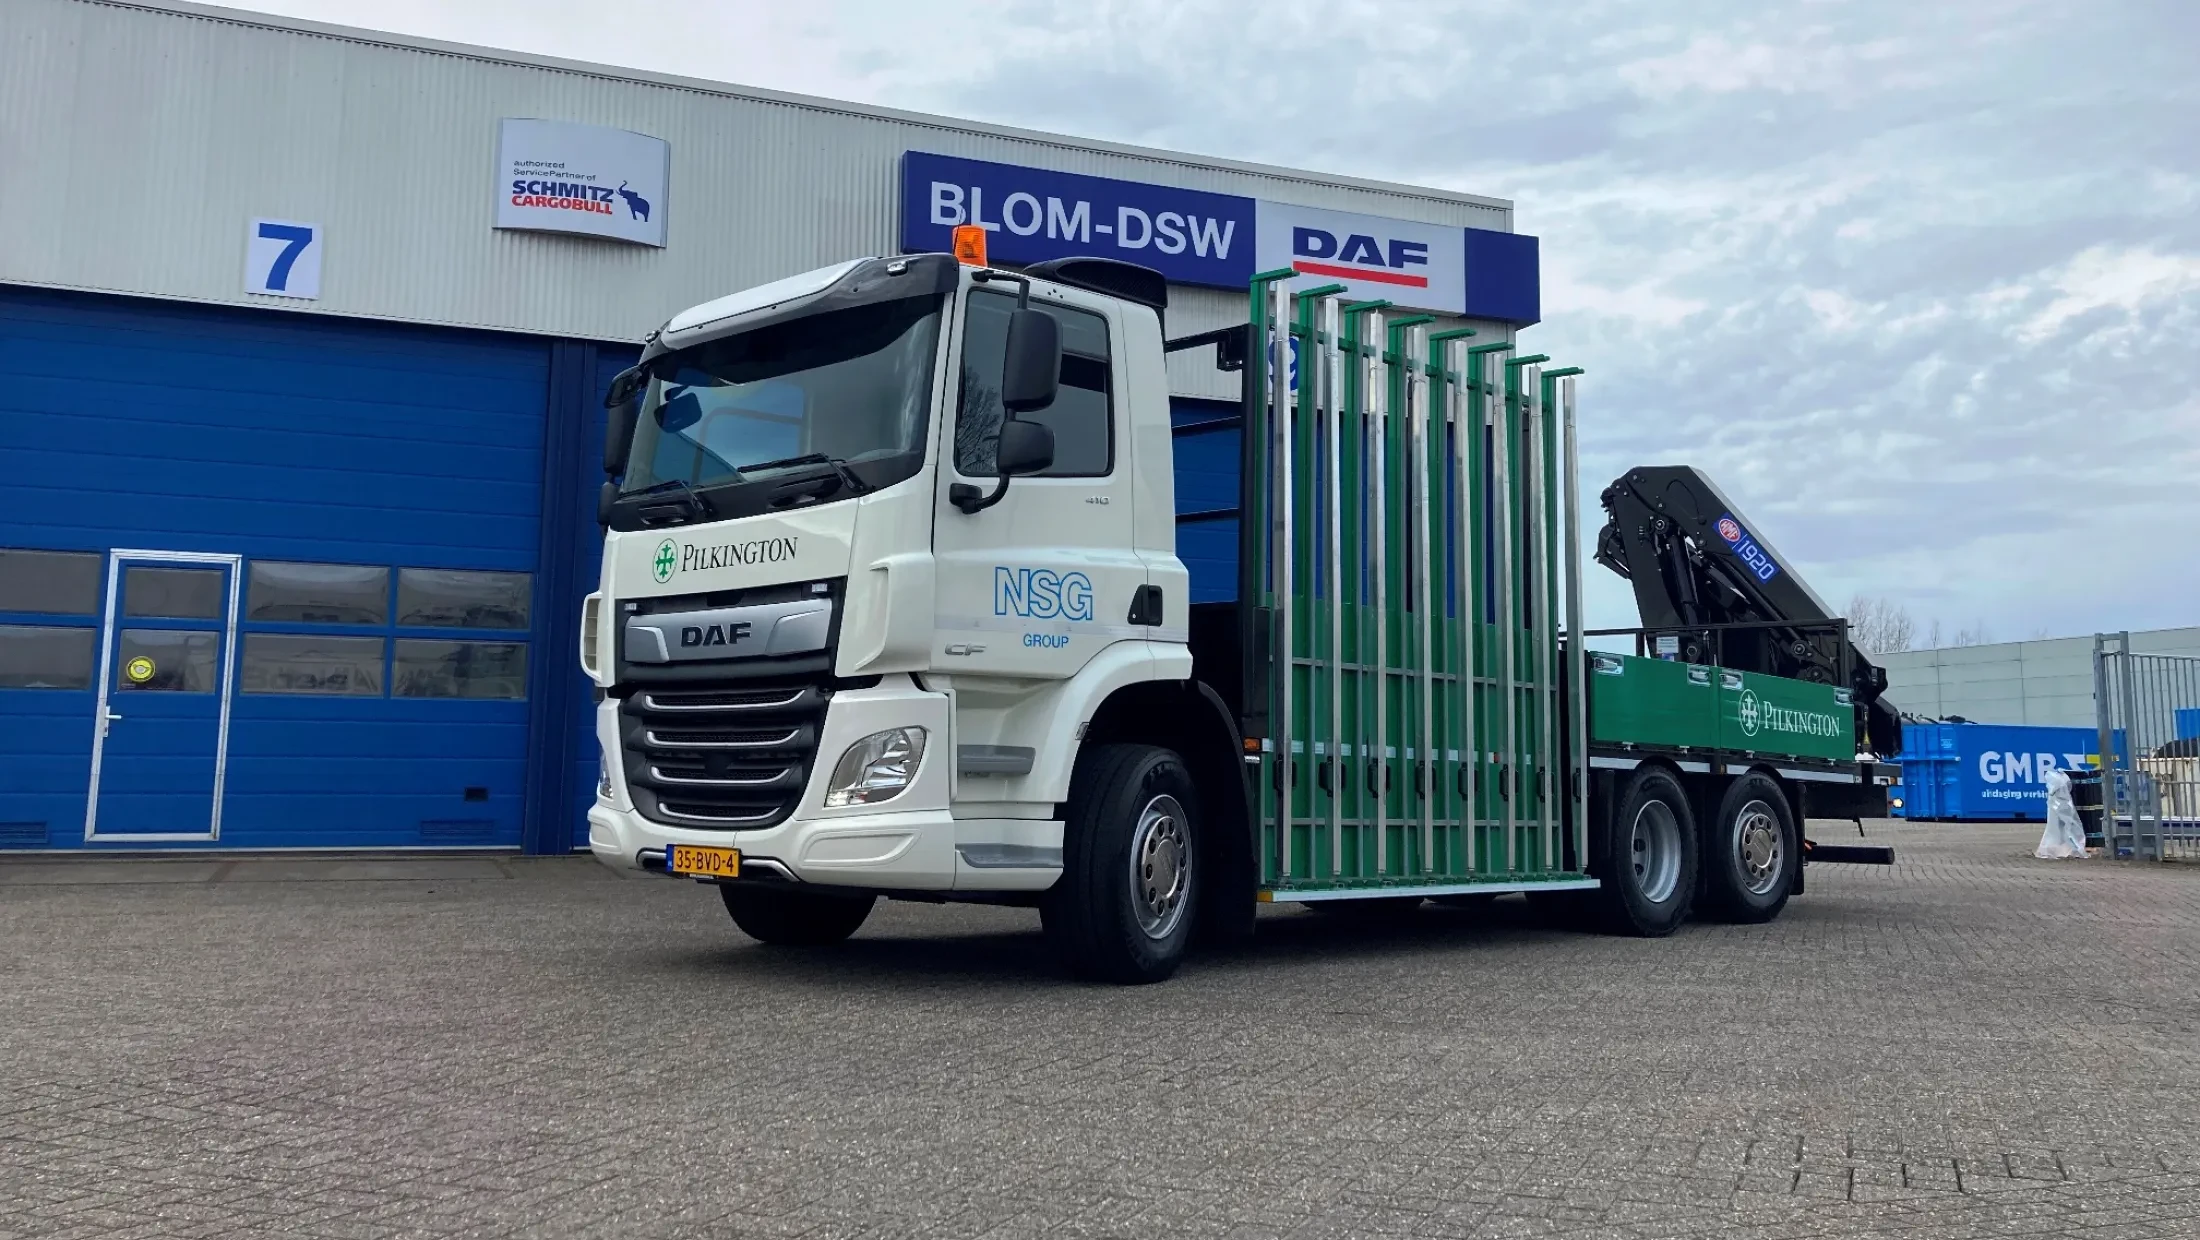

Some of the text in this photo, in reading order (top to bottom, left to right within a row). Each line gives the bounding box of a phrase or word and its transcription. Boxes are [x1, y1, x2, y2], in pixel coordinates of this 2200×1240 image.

[513, 160, 565, 169] authorized
[511, 195, 613, 215] CARGOBULL
[512, 180, 614, 203] SCHMITZ
[930, 181, 1236, 260] BLOM-DSW
[258, 222, 313, 291] 7
[1292, 226, 1428, 268] DAF
[681, 537, 798, 572] PILKINGTON
[1737, 540, 1775, 579] 1920
[994, 566, 1093, 621] NSG
[681, 621, 752, 648] DAF
[944, 643, 987, 656] CF
[1023, 634, 1069, 648] GROUP
[1763, 700, 1840, 737] PILKINGTON
[1979, 751, 2056, 784] GMB
[676, 850, 734, 873] 35-BVD-4
